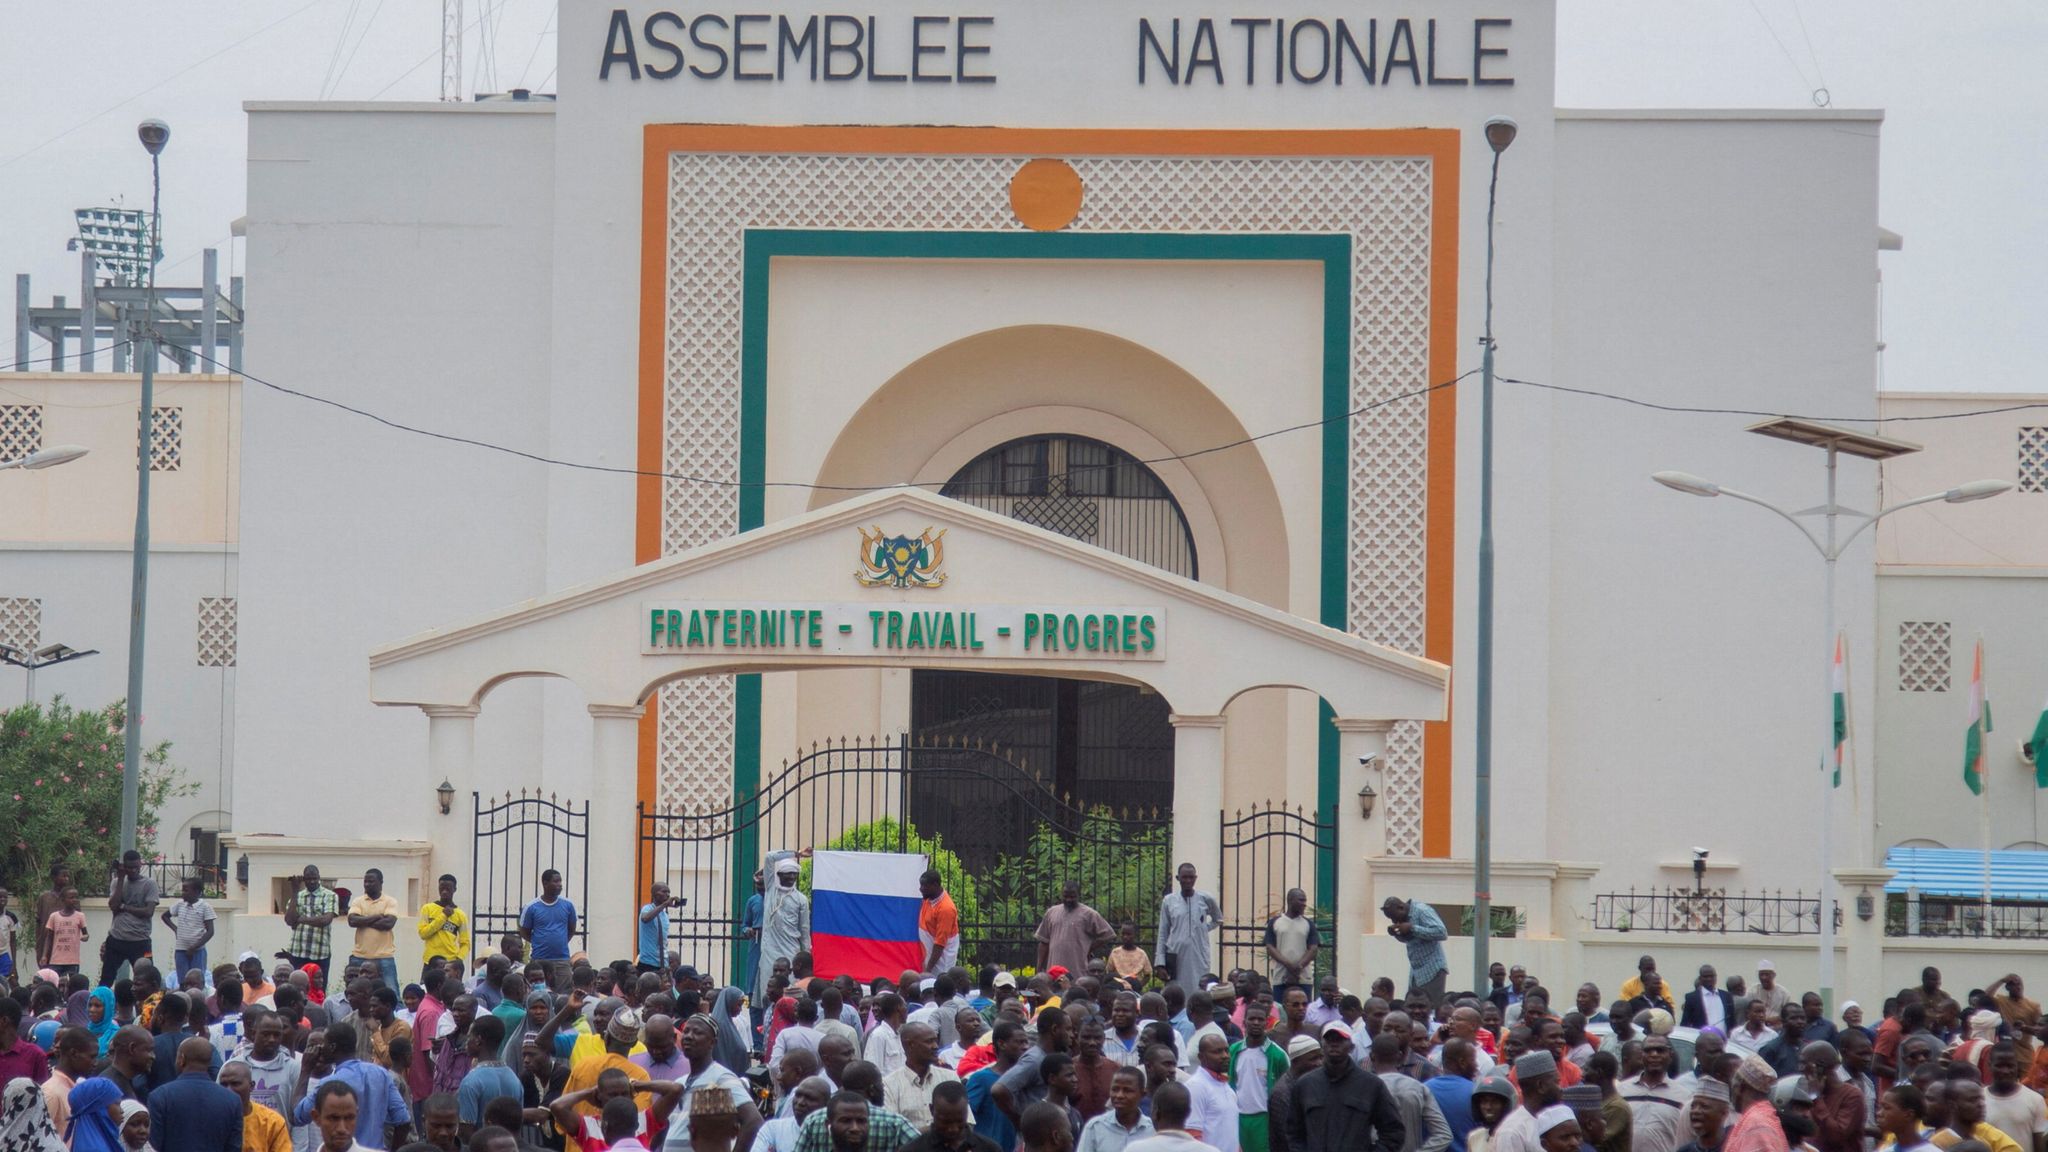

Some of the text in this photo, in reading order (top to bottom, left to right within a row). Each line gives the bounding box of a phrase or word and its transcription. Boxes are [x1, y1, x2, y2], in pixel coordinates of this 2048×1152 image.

[600, 9, 1514, 85] ASSEMBLEE NATIONALE
[651, 609, 823, 647] FRATERNITE
[869, 611, 984, 649] TRAVAIL
[1024, 613, 1156, 652] PROGRES
